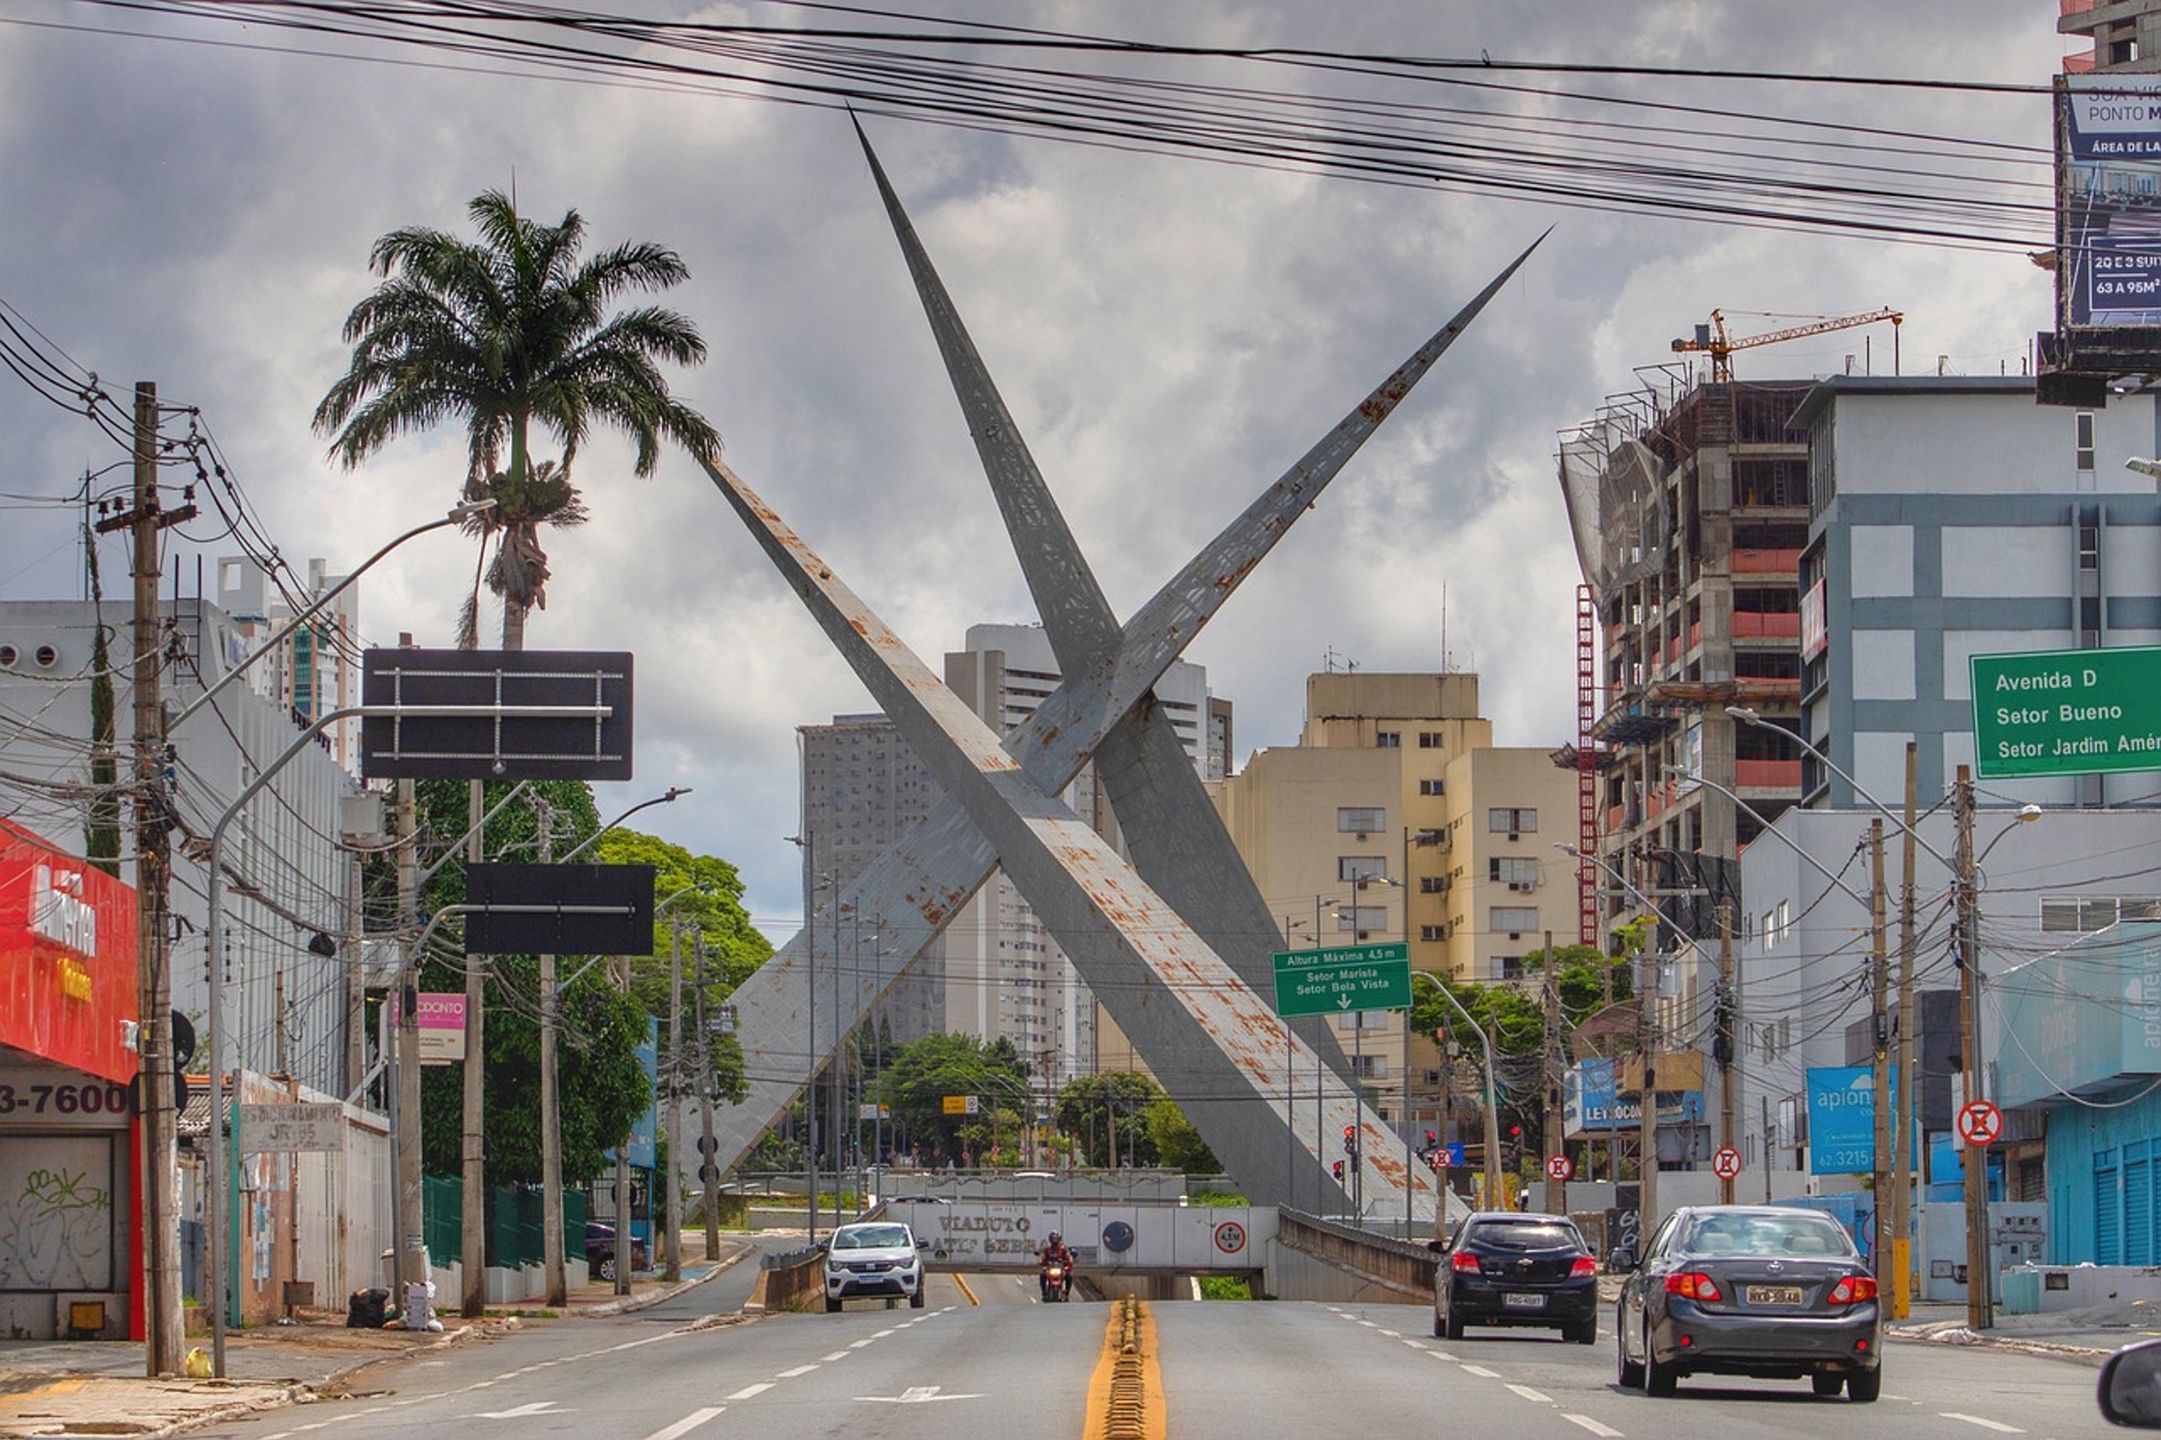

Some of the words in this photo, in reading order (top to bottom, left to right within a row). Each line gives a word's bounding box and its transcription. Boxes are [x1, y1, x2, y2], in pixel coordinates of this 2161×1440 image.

[2089, 106, 2144, 121] PONTO
[2092, 140, 2125, 153] ÁREA
[2127, 142, 2144, 152] DE
[2115, 256, 2123, 268] E
[2125, 256, 2134, 268] 3
[2096, 282, 2113, 294] 63
[2115, 282, 2125, 293] A
[1996, 671, 2072, 691] Avenida
[2083, 669, 2097, 687] D
[1997, 707, 2049, 725] Setor
[2060, 703, 2122, 722] Bueno
[1999, 741, 2044, 758] Setor
[2053, 737, 2109, 756] Jardim
[1287, 955, 1319, 967] Altura
[1323, 951, 1364, 963] Máxima
[1307, 971, 1335, 983] Setor
[1339, 968, 1378, 980] Marista
[1296, 984, 1327, 996] Setor
[1331, 981, 1357, 993] Bela
[1361, 979, 1390, 990] Vista
